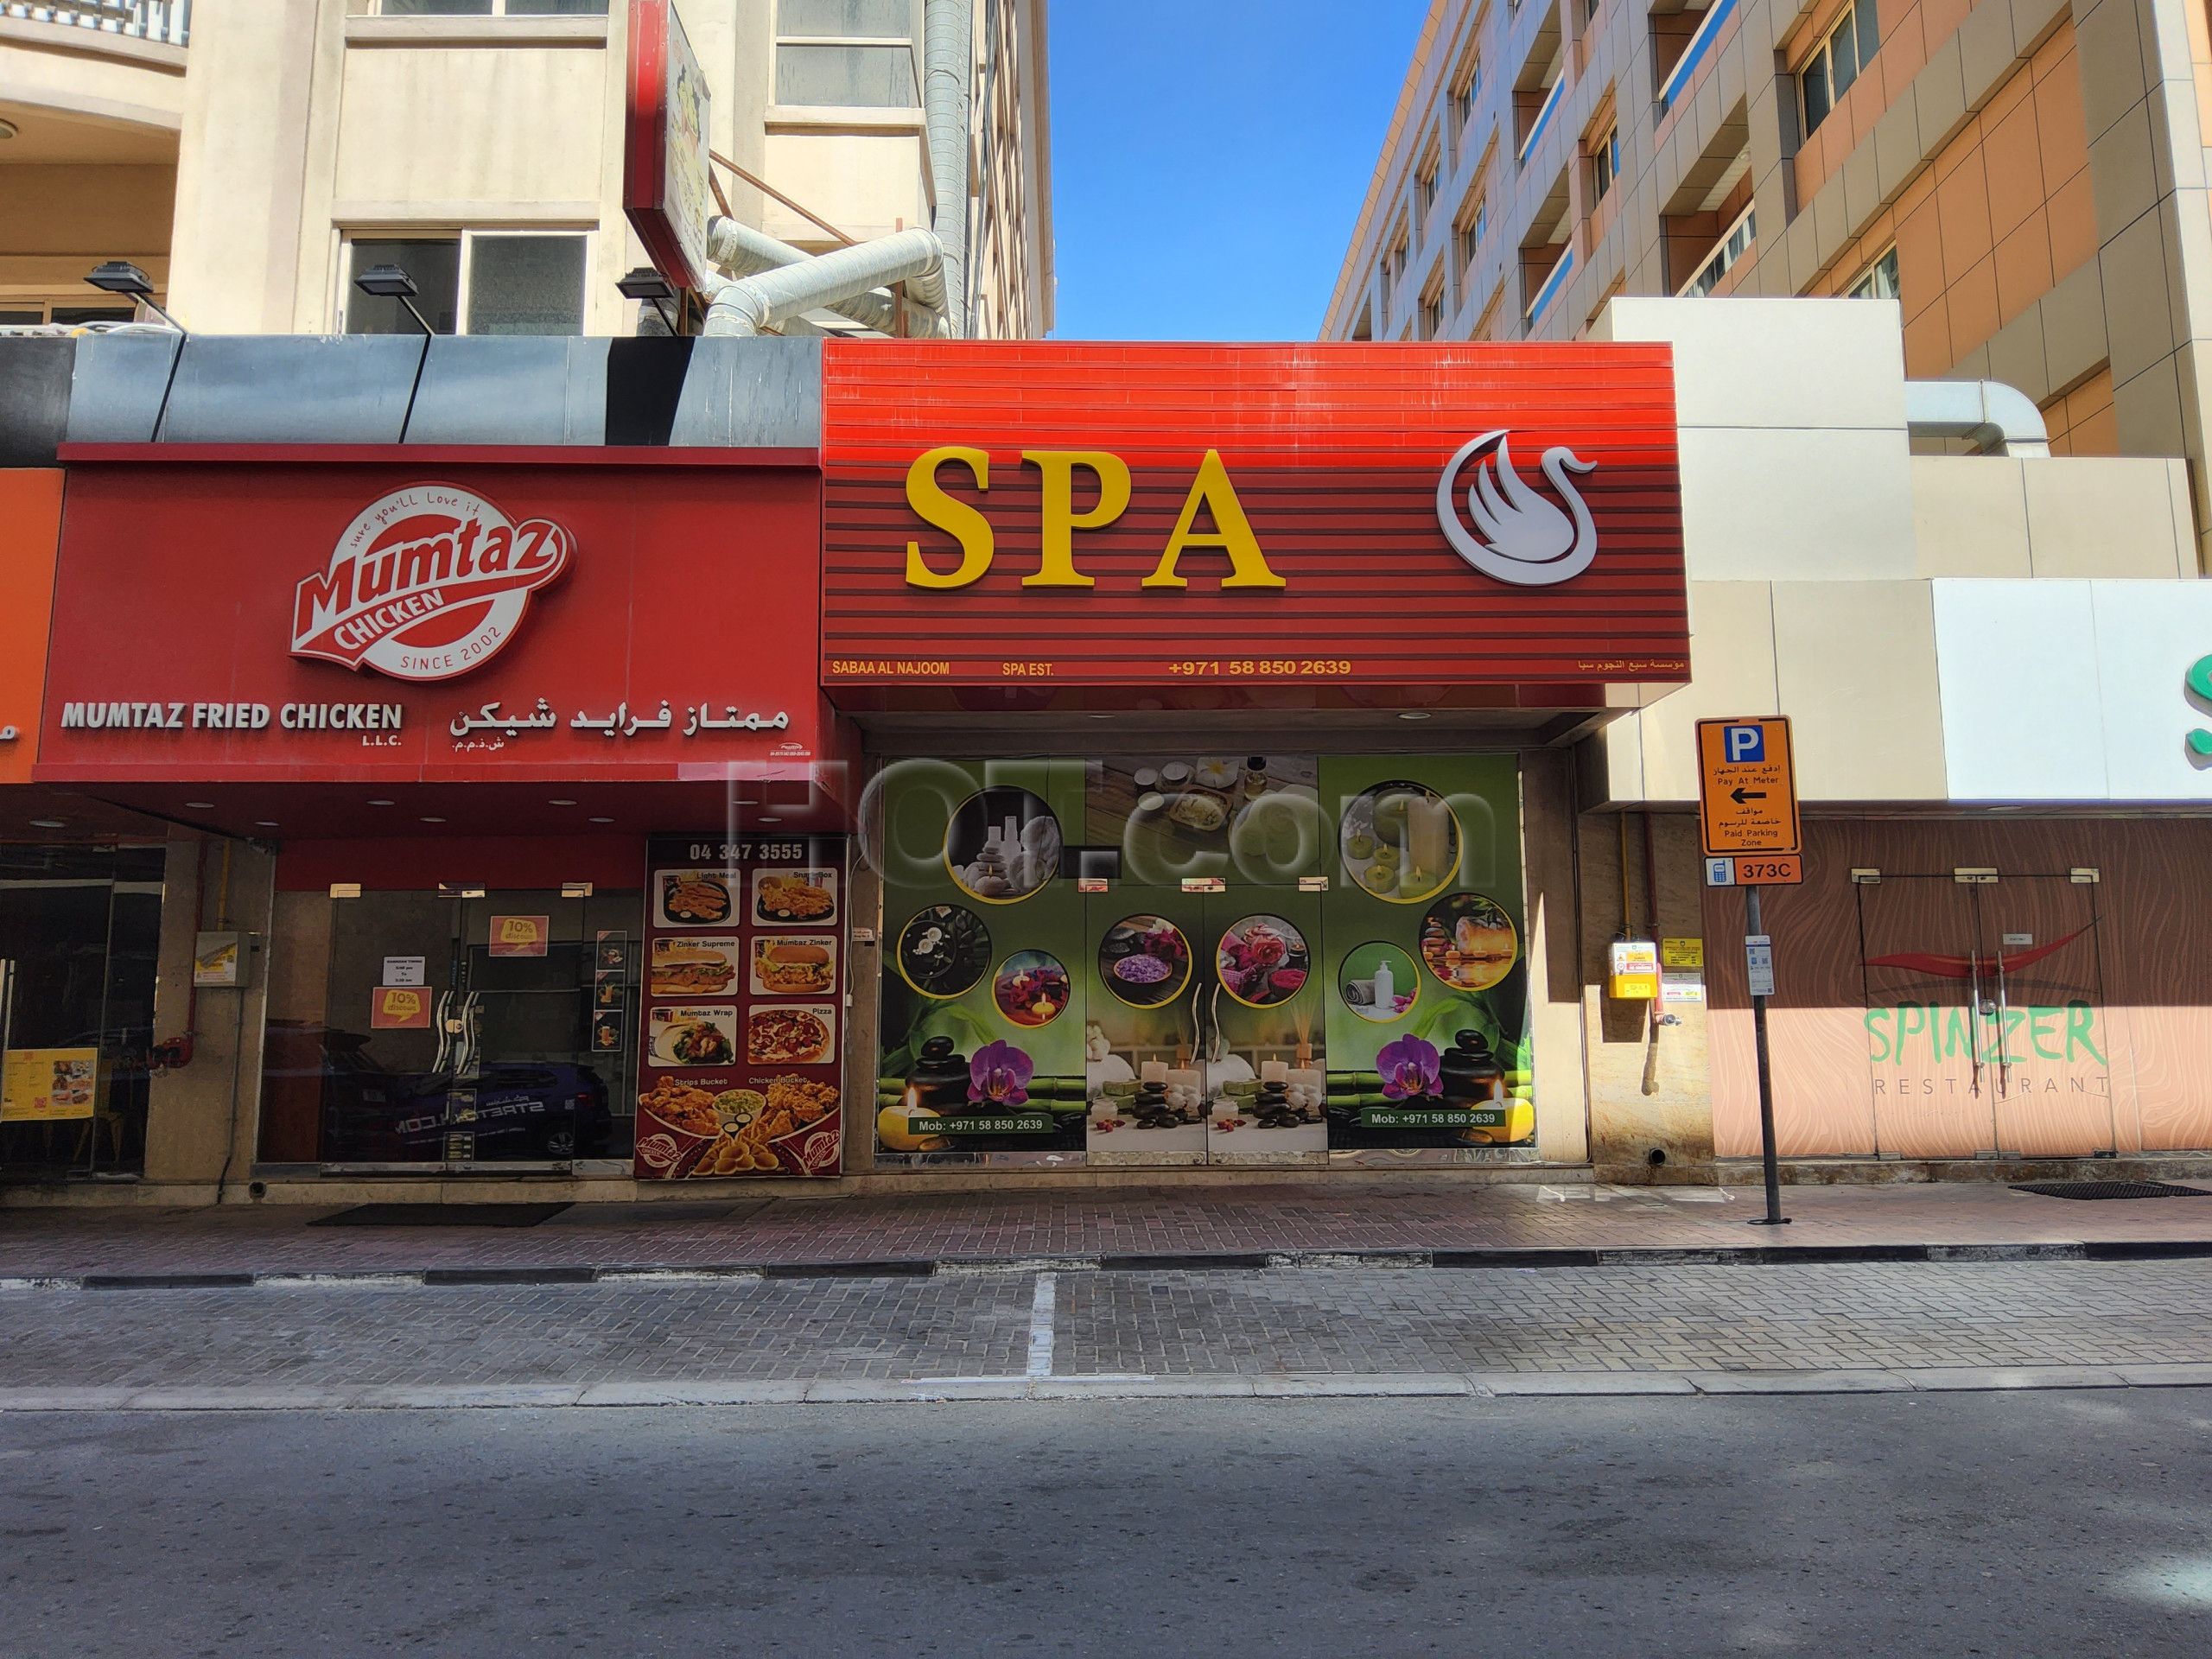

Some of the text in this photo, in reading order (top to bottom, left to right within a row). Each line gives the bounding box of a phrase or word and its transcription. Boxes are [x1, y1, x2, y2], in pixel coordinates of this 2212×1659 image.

[350, 522, 372, 548] sure
[466, 500, 481, 516] it
[906, 446, 1287, 588] SPA
[295, 516, 562, 641] Mumtaz
[334, 589, 445, 651] CHICKEN
[400, 626, 502, 671] SINCE 2002
[832, 660, 1054, 677] SABAA AL NAJOOM SPA EST.
[1168, 660, 1351, 676] +971 58 850 2639
[60, 702, 402, 730] MUMTAZ FRIED CHICKEN
[449, 697, 790, 737] ممتاز فرايد شيكن
[361, 734, 402, 747] L.L.C.
[1731, 728, 1759, 761] P
[1717, 778, 1733, 786] Pay
[1718, 817, 1782, 828] خاضعة للرسوم
[1746, 829, 1778, 838] Parking
[690, 843, 803, 860] 04 347 3555
[1743, 863, 1792, 879] 373C
[509, 920, 533, 933] 10%
[702, 940, 735, 949] Supreme
[391, 992, 416, 1005] 10%
[713, 1009, 734, 1018] Wrap
[1863, 1000, 2107, 1066] SPINZER
[674, 1078, 699, 1088] Strips
[1874, 1076, 2109, 1096] RESTAURANT
[918, 1120, 1043, 1131] Mob: +971 58 850 2639
[1371, 1113, 1496, 1124] Mob: +971 58 850 2639
